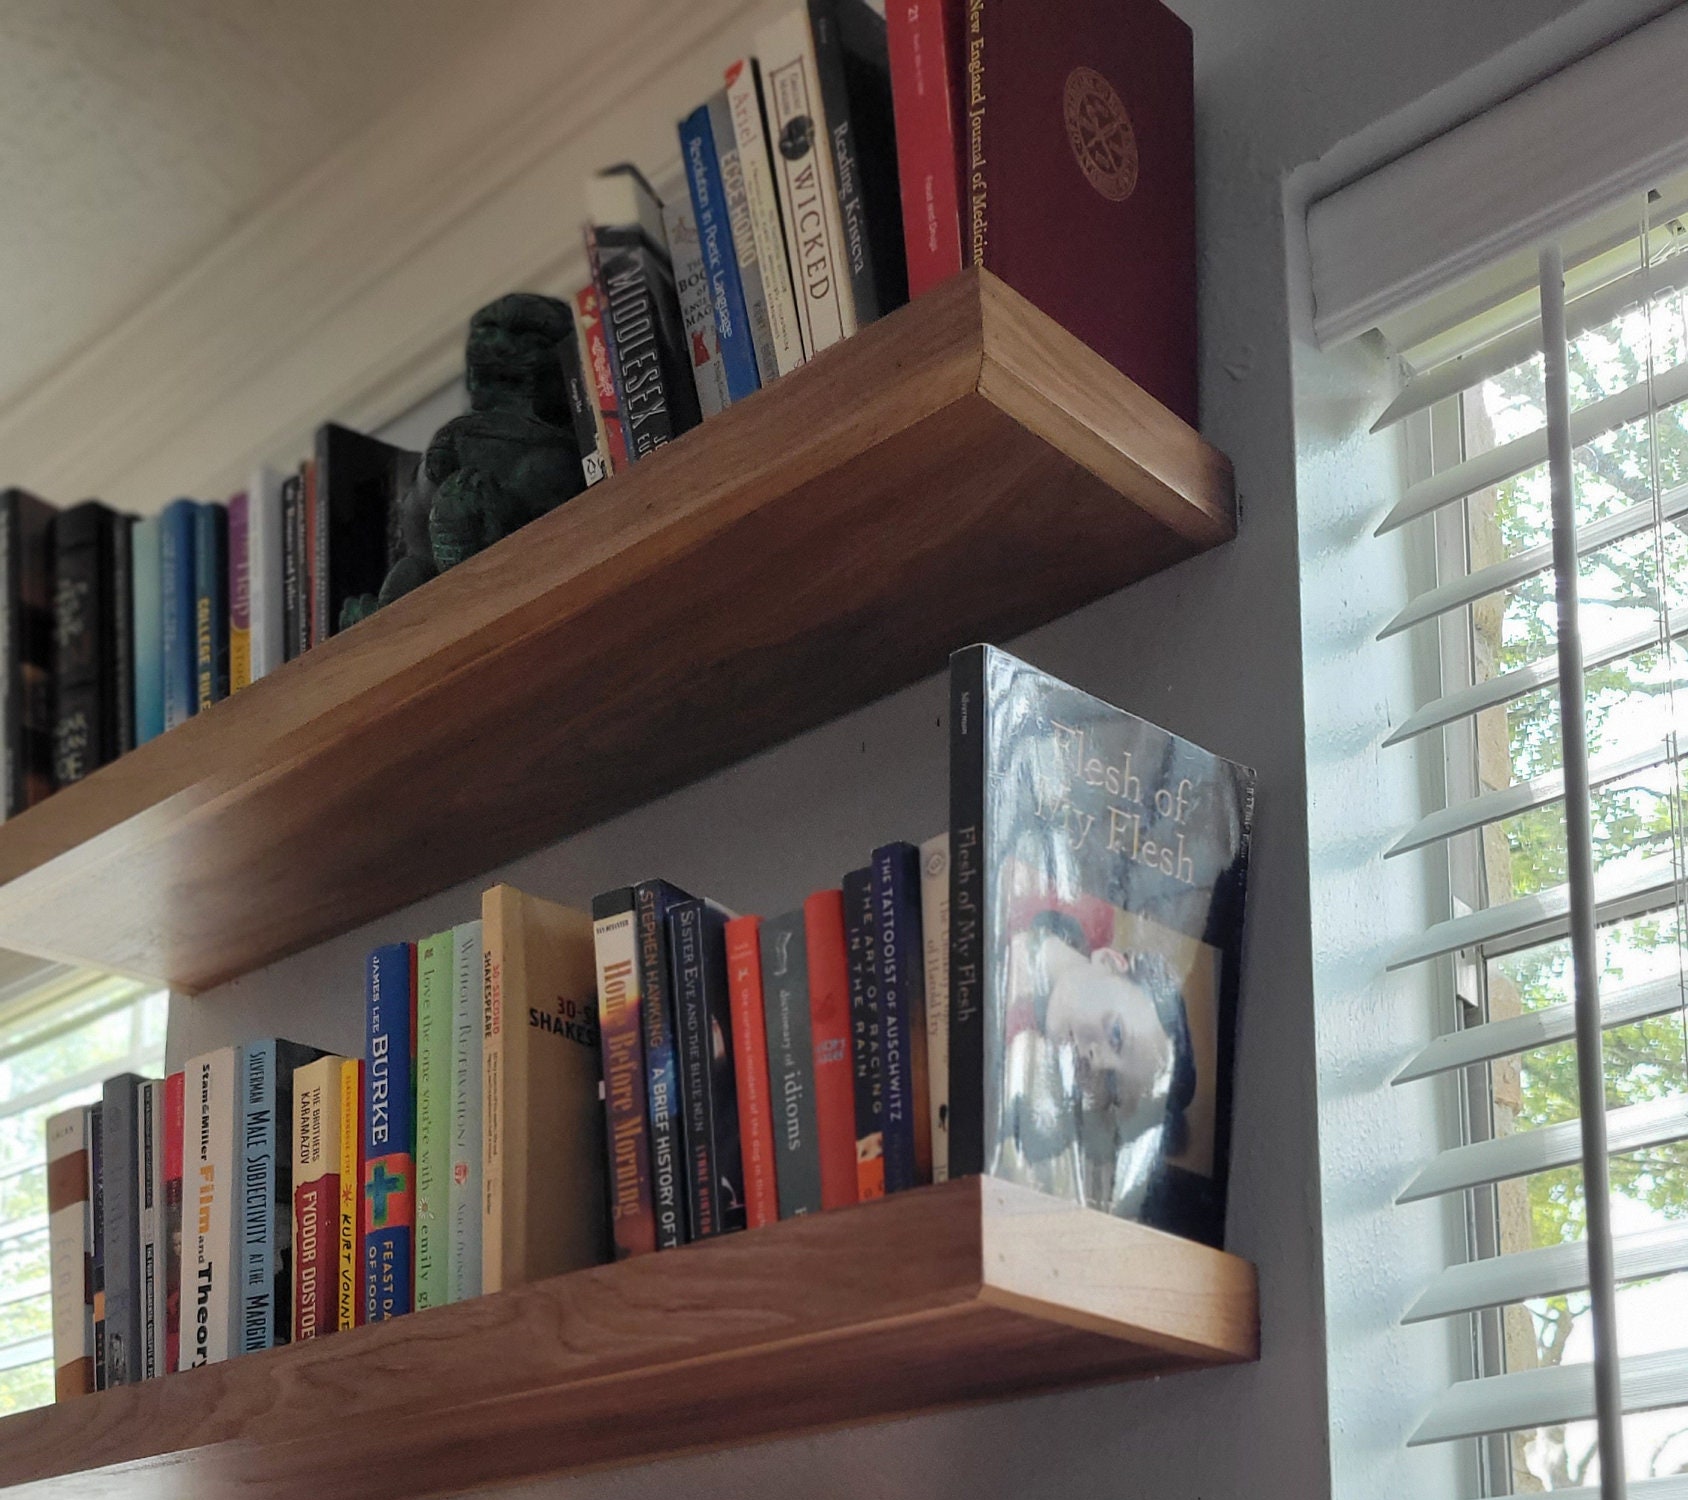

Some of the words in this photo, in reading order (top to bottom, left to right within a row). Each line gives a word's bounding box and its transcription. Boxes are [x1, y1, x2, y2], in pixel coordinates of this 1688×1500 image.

[969, 0, 985, 33] New
[968, 36, 986, 104] England
[732, 91, 757, 149] Ariel
[969, 107, 987, 170] Journal
[834, 121, 854, 200] Reading
[845, 197, 865, 275] Kristeva
[972, 171, 987, 190] of
[794, 163, 830, 300] WICKED
[972, 190, 989, 267] Medicine
[705, 224, 719, 269] Poetic
[712, 270, 733, 339] Language
[607, 255, 667, 429] MIDDLESEX
[1050, 718, 1145, 805] Flesh
[1154, 778, 1192, 825] of
[957, 825, 977, 881] Flesh
[1034, 776, 1095, 850] My
[1106, 806, 1195, 885] Flesh
[881, 856, 891, 888] THE
[958, 884, 977, 912] of
[640, 890, 660, 966] STEPHEN
[862, 881, 872, 925] THE
[680, 910, 695, 964] SISTER
[851, 927, 860, 952] IN
[864, 935, 876, 974] ART
[881, 889, 896, 985] TATTOOIST
[952, 917, 977, 951] My
[371, 956, 381, 1002] JAMES
[423, 967, 435, 1008] love
[483, 950, 493, 1039] SHAKESPEARE
[682, 965, 698, 993] EVE
[852, 963, 863, 1010] THE
[867, 984, 878, 1013] OF
[887, 991, 896, 1010] OF
[957, 953, 978, 1022] Flesh
[371, 1004, 381, 1034] LEE
[422, 1011, 432, 1041] the
[529, 1007, 596, 1049] SHAKES
[645, 968, 663, 1048] HAWKING
[686, 994, 698, 1030] AND
[779, 989, 791, 1054] dictionary
[422, 1049, 431, 1076] one
[688, 1030, 699, 1058] THE
[783, 1055, 794, 1067] of
[856, 1021, 866, 1079] RAIN
[869, 1021, 882, 1116] RACING
[886, 1015, 902, 1122] AUSCHWITZ
[248, 1050, 266, 1104] SILVERMAN
[313, 1085, 321, 1103] THE
[371, 1033, 390, 1147] BURKE
[608, 1029, 638, 1113] Before
[651, 1067, 663, 1080] A
[689, 1060, 702, 1093] BLUE
[247, 1109, 271, 1148] MALE
[300, 1091, 311, 1165] KARAMAZOV
[419, 1078, 431, 1146] you're
[653, 1079, 670, 1131] BRIEF
[693, 1094, 704, 1133] NUN
[783, 1072, 803, 1152] idioms
[312, 1103, 321, 1162] BROTHERS
[422, 1152, 434, 1191] with
[614, 1116, 645, 1221] Morning
[656, 1134, 674, 1206] HISTORY
[696, 1145, 709, 1183] LYNNE
[198, 1164, 215, 1234] Film
[246, 1153, 271, 1244] SUBJECTIVITY
[662, 1211, 676, 1231] OF
[700, 1185, 712, 1235] HINTON
[198, 1235, 206, 1263] and
[302, 1189, 318, 1263] FYODOR
[341, 1213, 353, 1265] KURT
[249, 1253, 264, 1268] AT
[249, 1270, 263, 1285] THE
[369, 1245, 378, 1267] OF
[382, 1240, 395, 1293] FEAST
[418, 1224, 430, 1281] emily
[191, 1261, 213, 1369] Theory
